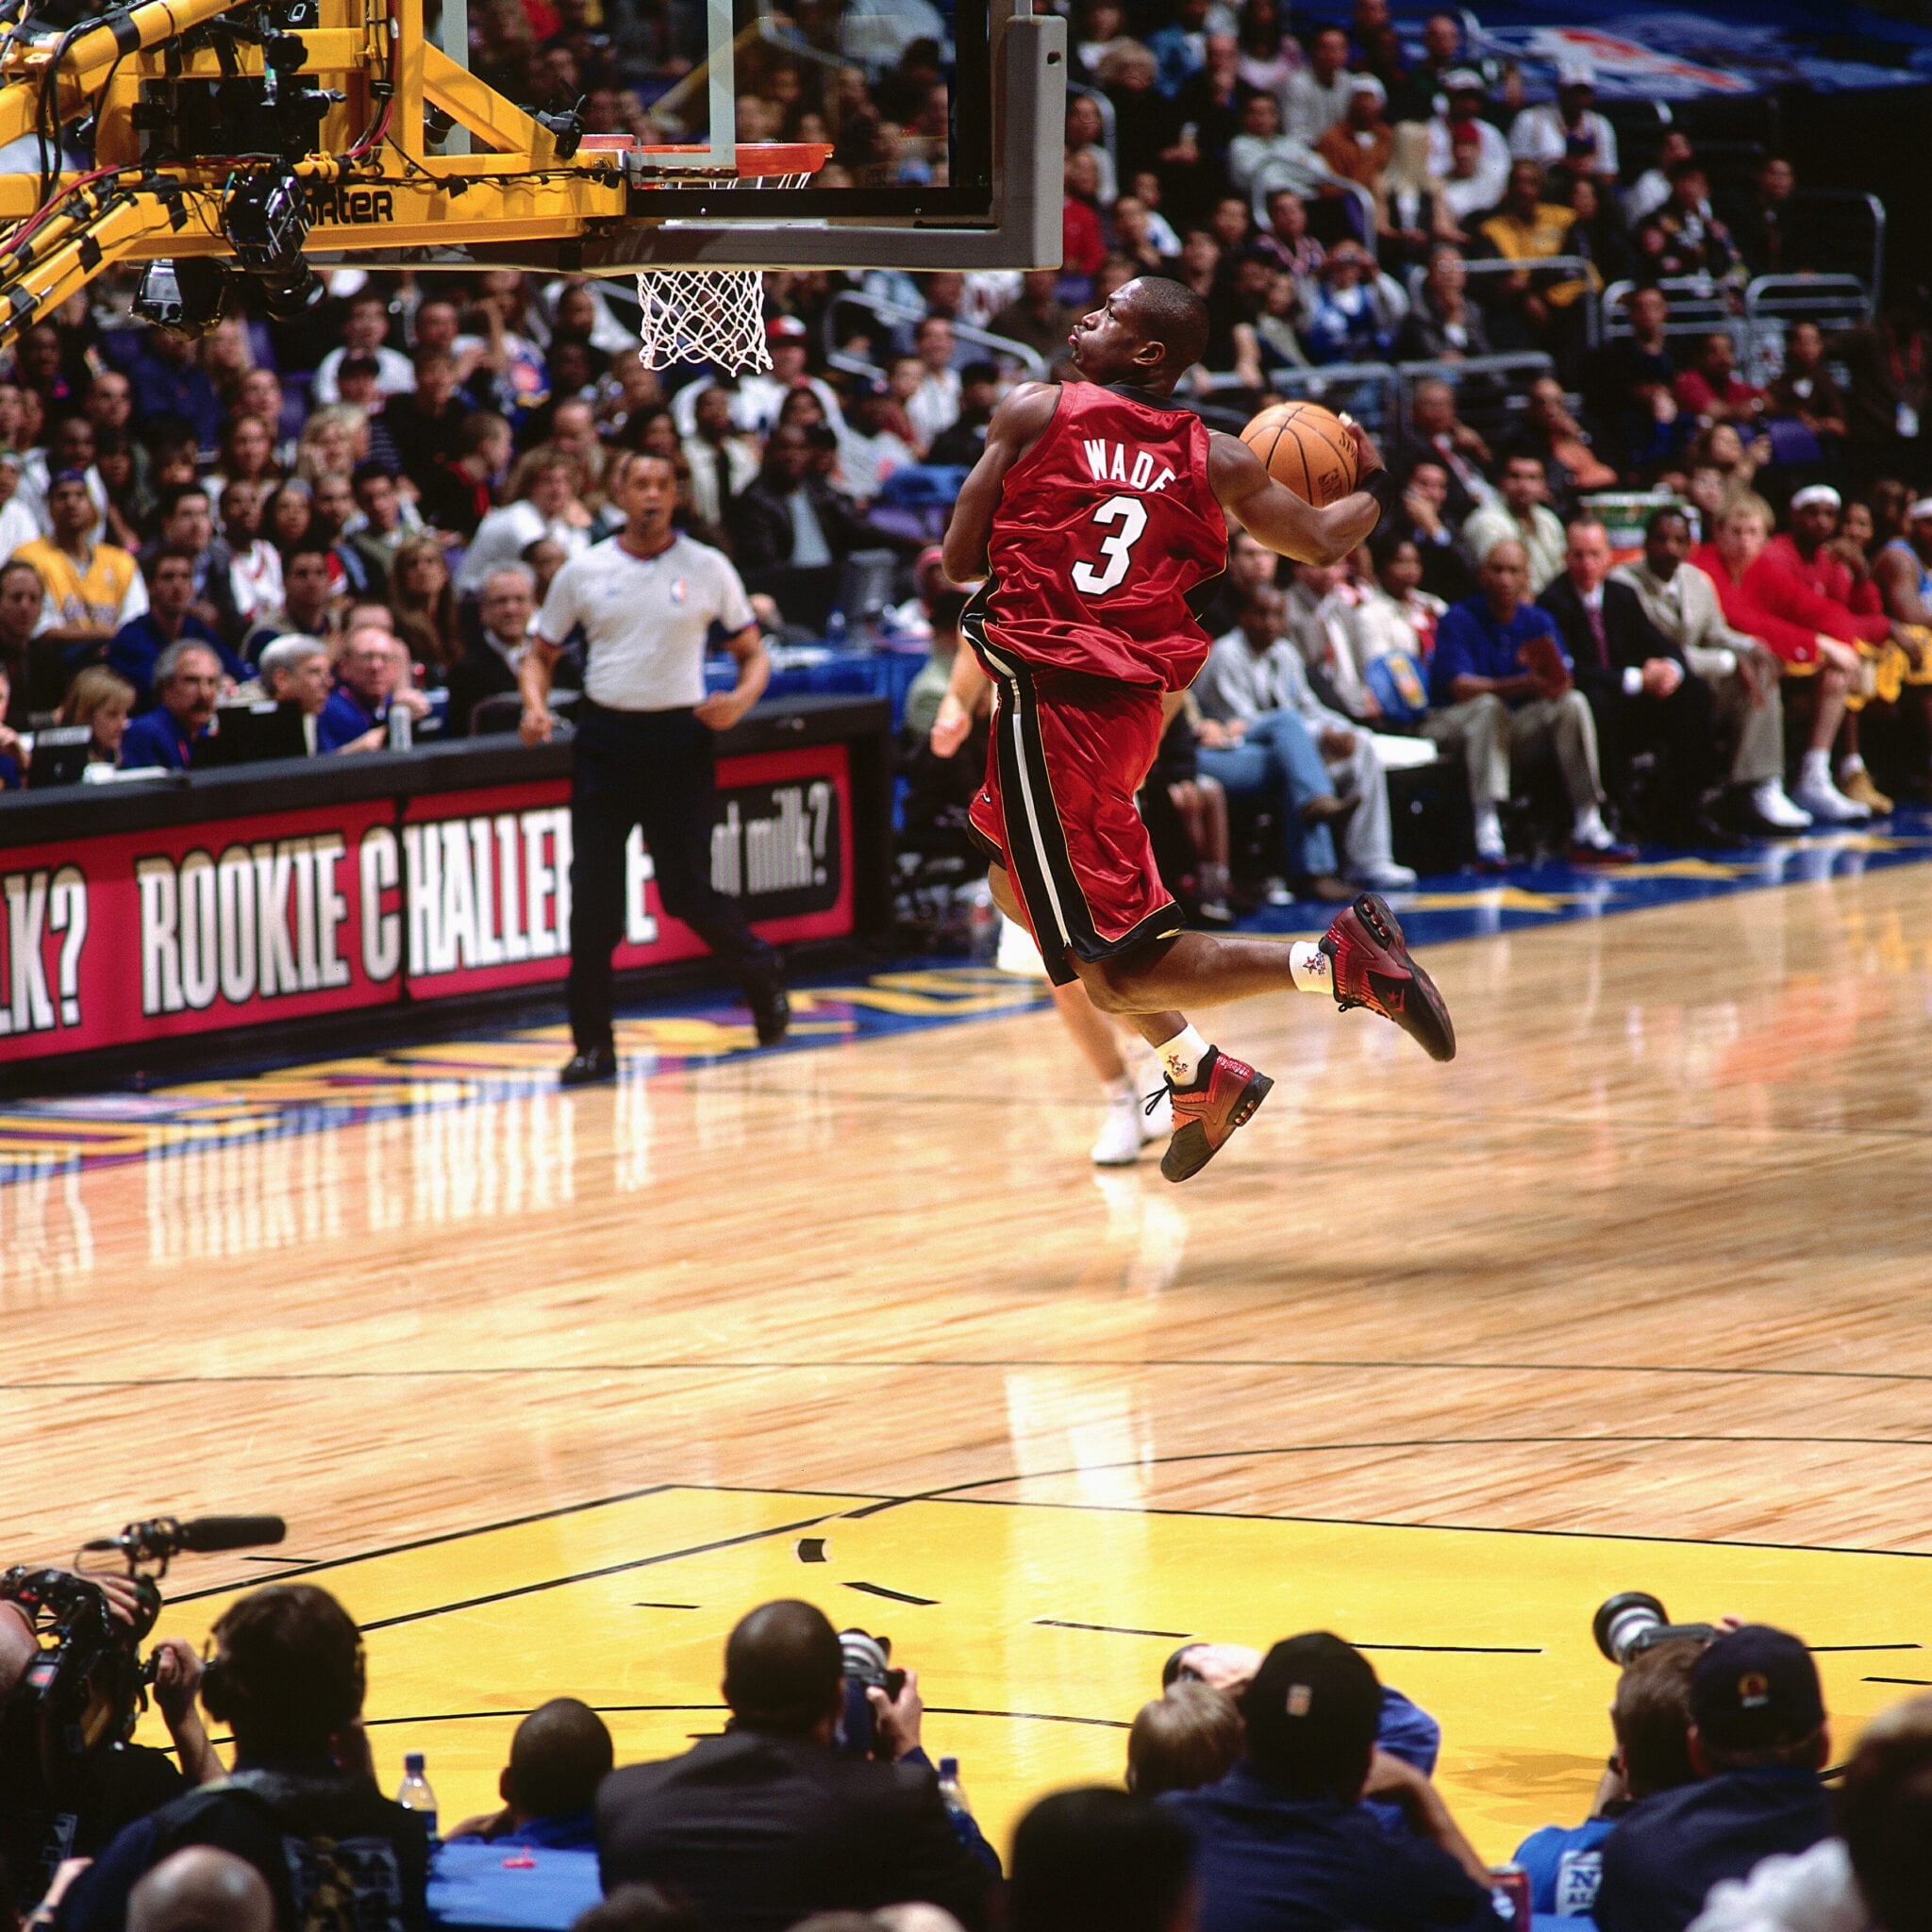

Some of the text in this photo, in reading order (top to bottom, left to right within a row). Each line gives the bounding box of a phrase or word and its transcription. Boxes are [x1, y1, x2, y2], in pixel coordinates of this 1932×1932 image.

[1070, 494, 1148, 595] 3
[710, 781, 828, 897] ot milk?
[135, 807, 658, 1016] ROOKIE CHALLEE
